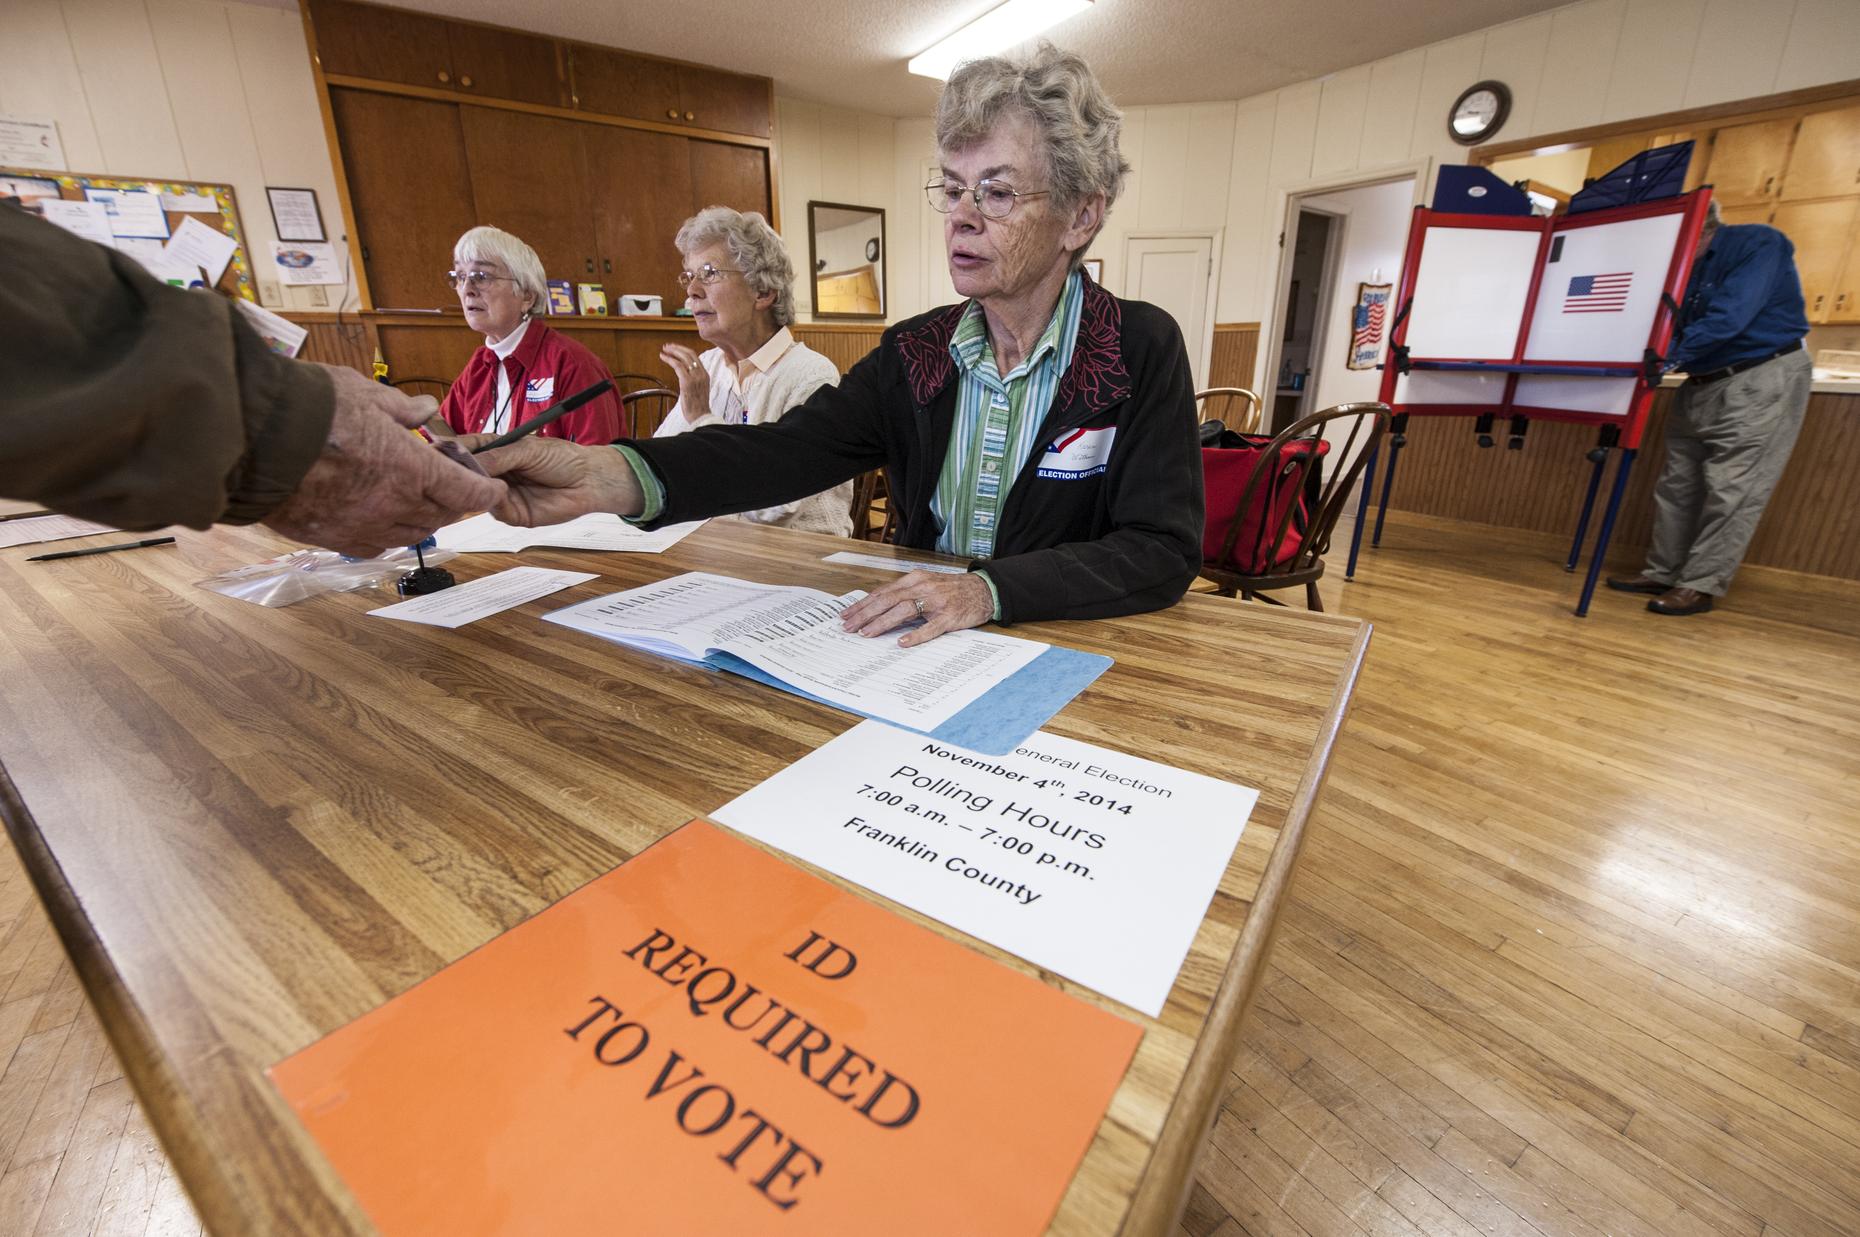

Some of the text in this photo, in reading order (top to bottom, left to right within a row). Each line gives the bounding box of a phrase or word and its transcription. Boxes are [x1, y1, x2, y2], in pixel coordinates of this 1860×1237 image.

[1038, 469, 1078, 480] ELECTION
[890, 765, 1107, 849] Polling Hours
[921, 743, 1030, 783] November
[1073, 789, 1134, 816] 2014
[1015, 746, 1173, 799] eneral Election
[843, 816, 1043, 905] Franklin County
[856, 783, 904, 807] 7:00
[904, 803, 949, 827] a.m.
[979, 827, 1034, 856] 7:00
[1035, 852, 1095, 881] p.m.
[783, 930, 858, 981] ID
[621, 927, 921, 1131] REQUIRED
[563, 995, 824, 1214] TO VOTE
